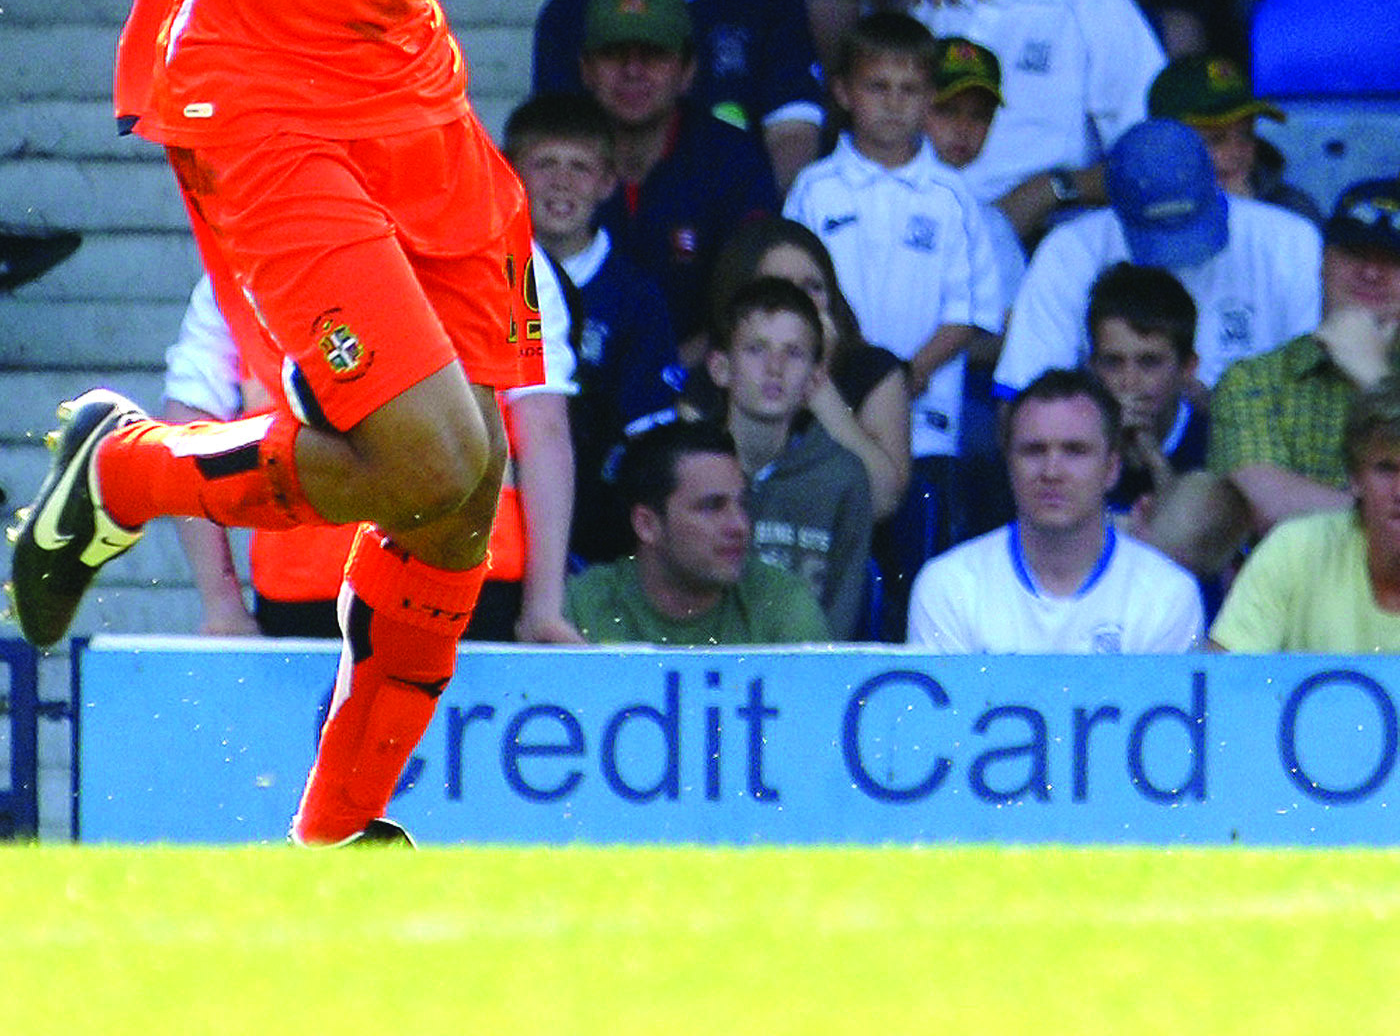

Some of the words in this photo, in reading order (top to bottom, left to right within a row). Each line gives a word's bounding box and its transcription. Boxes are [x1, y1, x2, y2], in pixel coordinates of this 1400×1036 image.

[391, 670, 780, 804] redit
[841, 669, 1209, 804] Card
[1277, 669, 1399, 804] O
